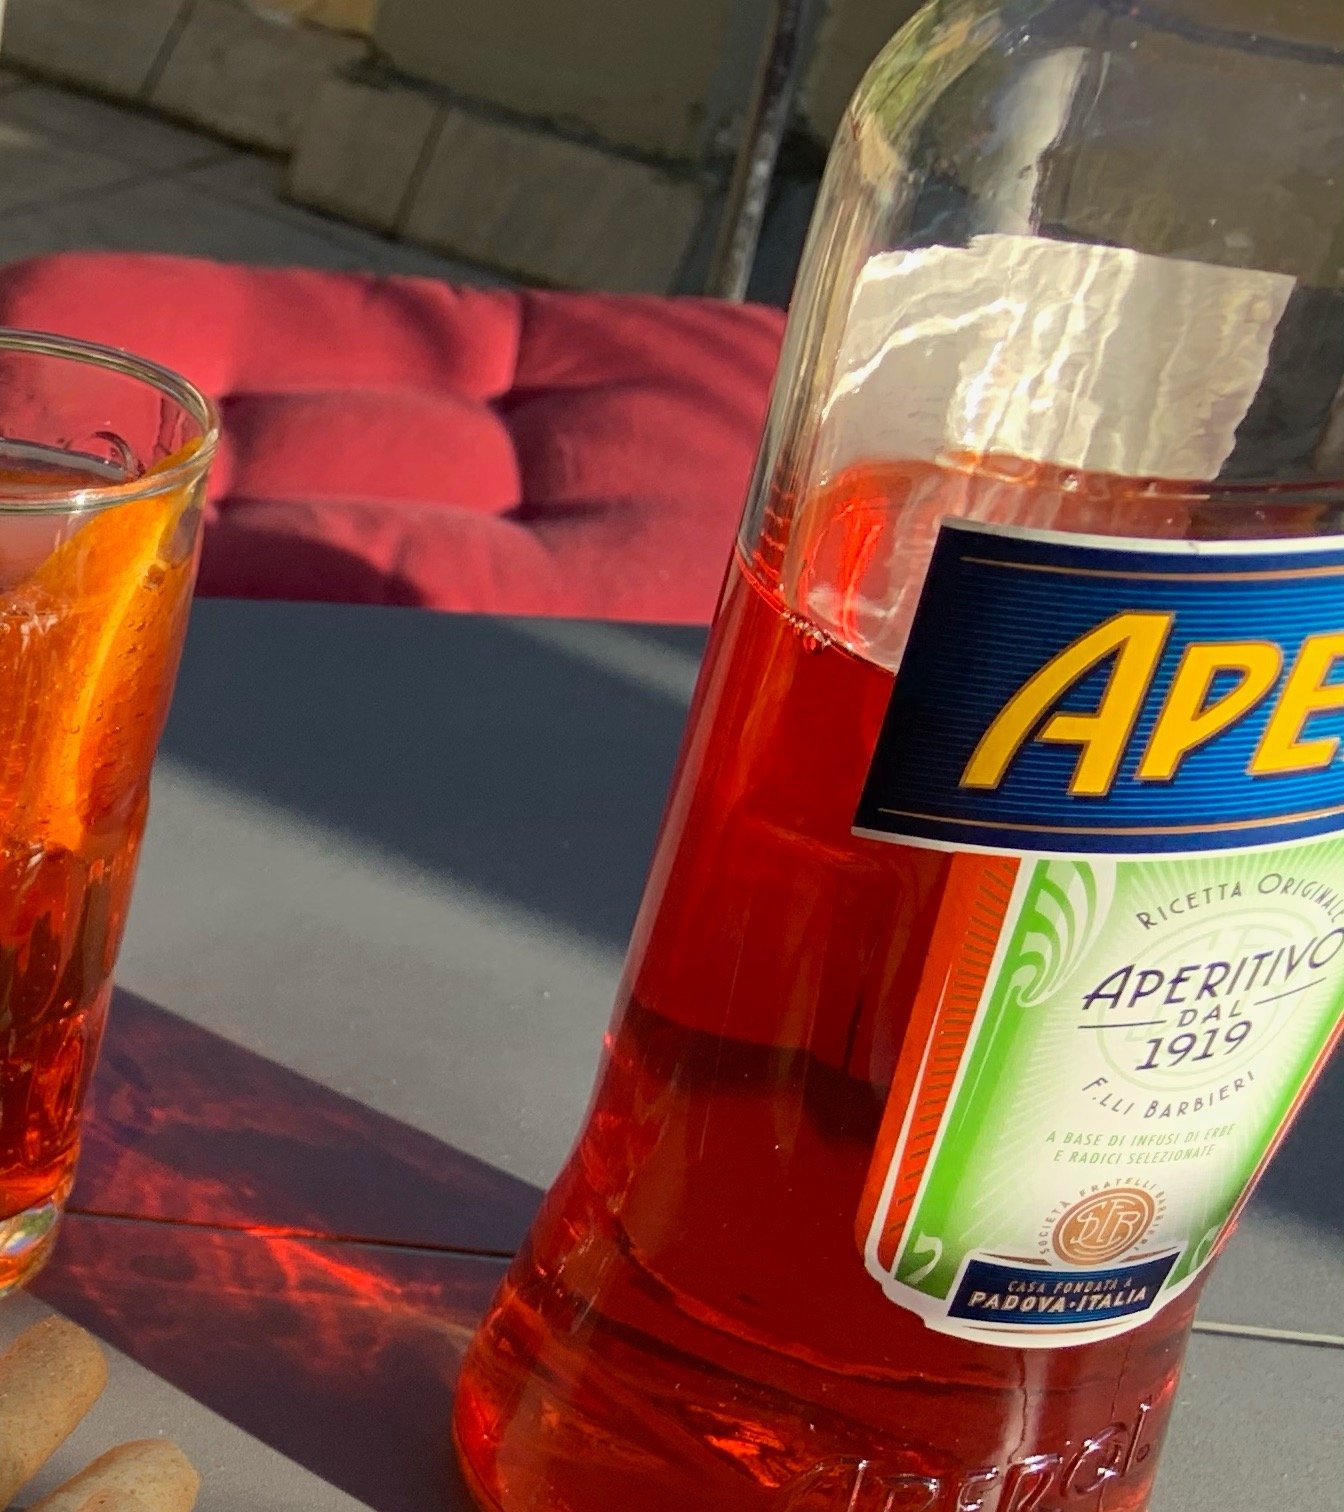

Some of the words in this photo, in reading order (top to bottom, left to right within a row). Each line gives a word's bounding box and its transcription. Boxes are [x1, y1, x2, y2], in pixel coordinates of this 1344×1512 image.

[958, 608, 1344, 797] APE
[1135, 880, 1243, 930] RICETTA
[1081, 926, 1344, 1011] APERITIVO
[1176, 999, 1243, 1028] DAL
[1134, 1019, 1253, 1071] 1919
[1143, 1070, 1255, 1119] BARBIERI
[1045, 1130, 1057, 1143] A
[1062, 1131, 1104, 1146] BASE
[1107, 1134, 1126, 1147] DI
[1130, 1132, 1180, 1147] INFUSI
[1184, 1131, 1200, 1143] DI
[1053, 1150, 1064, 1162] E
[1068, 1150, 1122, 1165] RADICI
[1128, 1144, 1216, 1165] SELEZIONATE
